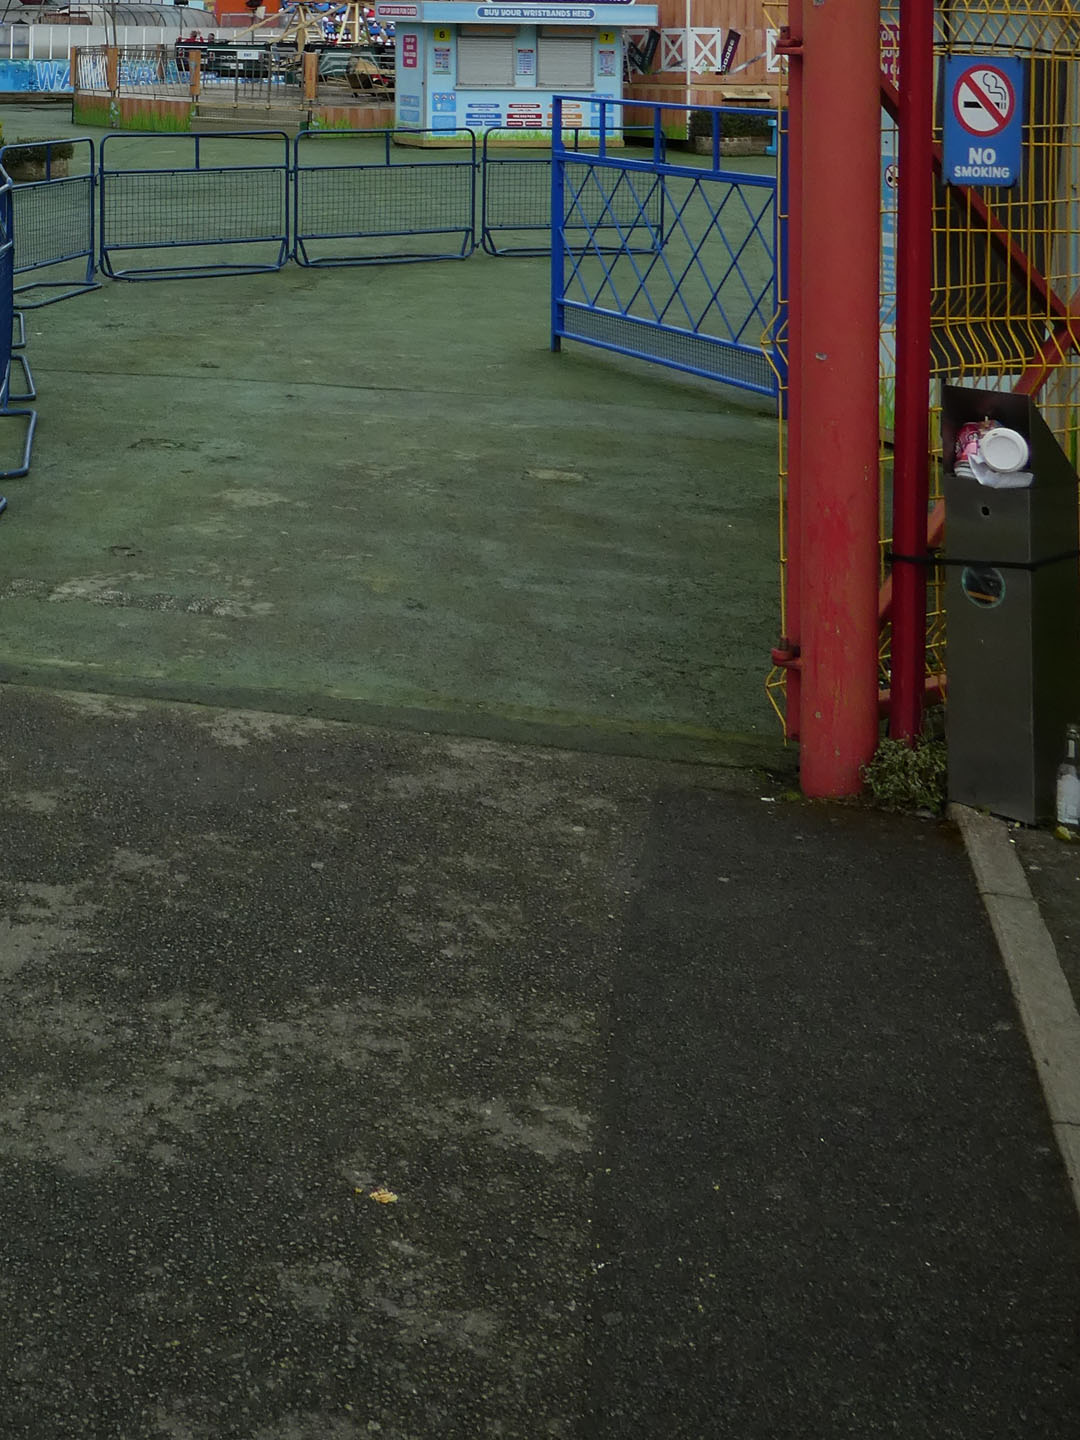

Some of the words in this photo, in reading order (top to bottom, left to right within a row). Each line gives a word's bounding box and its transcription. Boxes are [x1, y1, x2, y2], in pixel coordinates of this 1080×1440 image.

[484, 8, 499, 17] BUY
[501, 9, 521, 17] YOUR
[522, 9, 571, 18] WRISTBANDS
[572, 10, 590, 18] HERE
[968, 147, 997, 165] NO
[954, 165, 1010, 178] SMOKING
